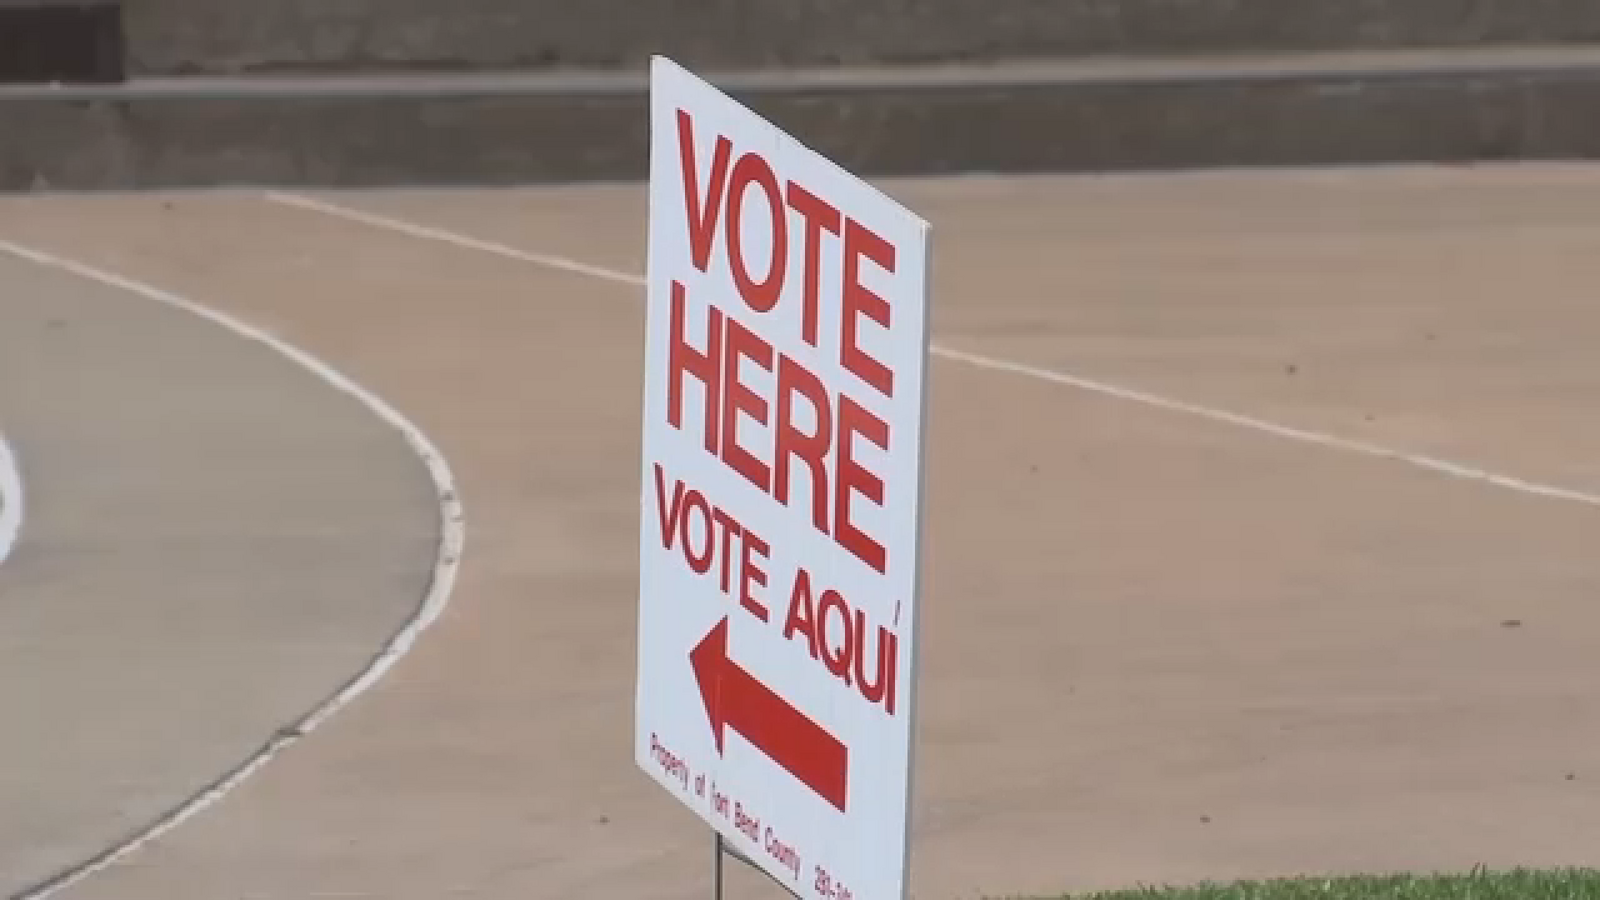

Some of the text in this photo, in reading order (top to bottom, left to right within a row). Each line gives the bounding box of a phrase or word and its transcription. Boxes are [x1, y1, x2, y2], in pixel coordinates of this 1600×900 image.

[676, 108, 896, 398] VOTE
[667, 279, 890, 575] HERE
[653, 462, 901, 716] VOTE AQUÍ
[650, 732, 689, 790] Property
[694, 774, 706, 798] of
[734, 801, 760, 843] Bend
[765, 826, 800, 881] County
